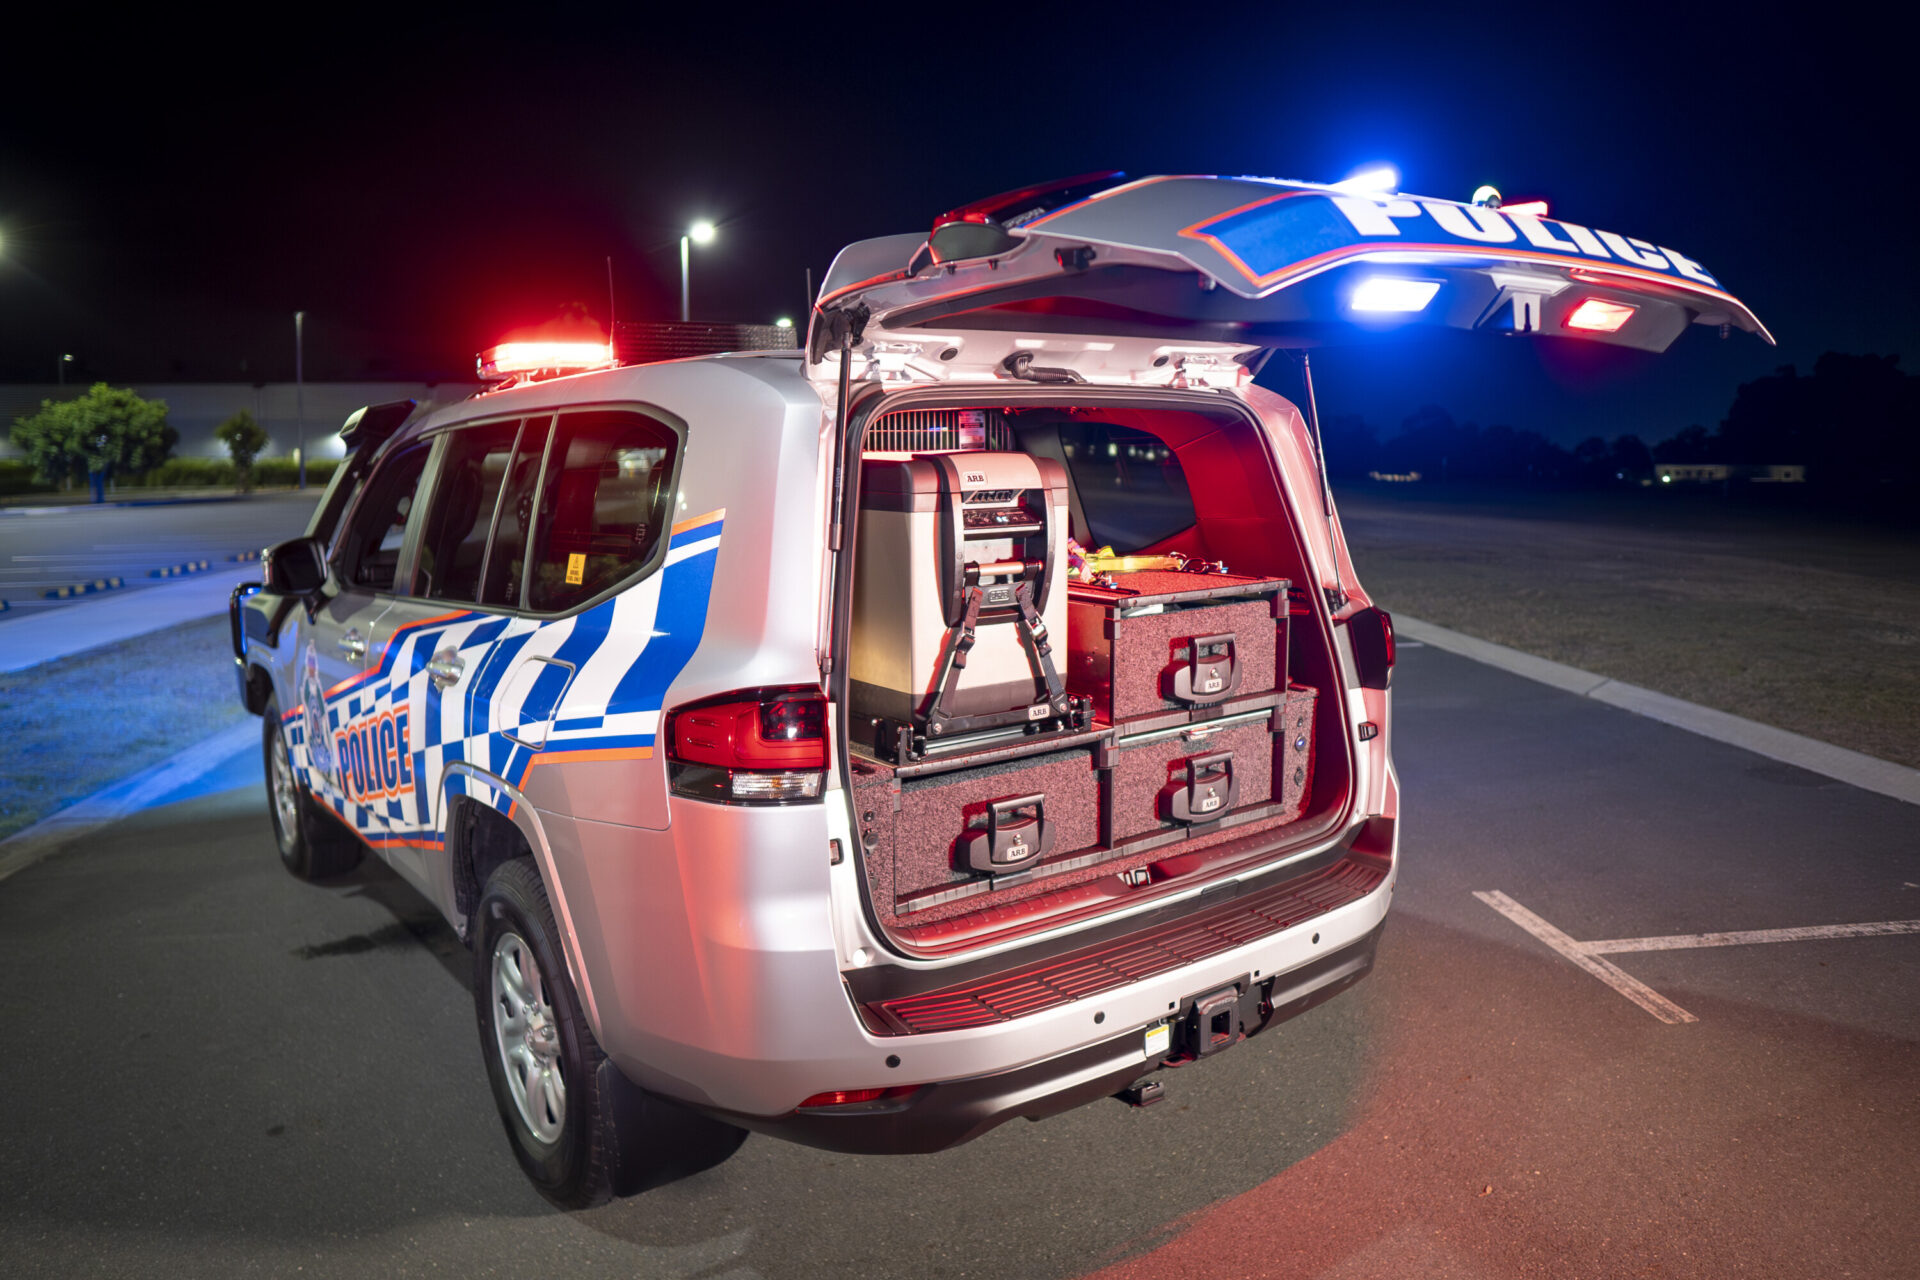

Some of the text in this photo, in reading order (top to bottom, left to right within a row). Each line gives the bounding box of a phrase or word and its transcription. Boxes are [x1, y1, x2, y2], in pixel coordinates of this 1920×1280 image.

[1330, 195, 1718, 288] POLICE
[967, 474, 985, 483] ARB
[1032, 708, 1048, 717] ARB
[336, 704, 413, 802] POLICE
[1010, 848, 1026, 857] ARB
